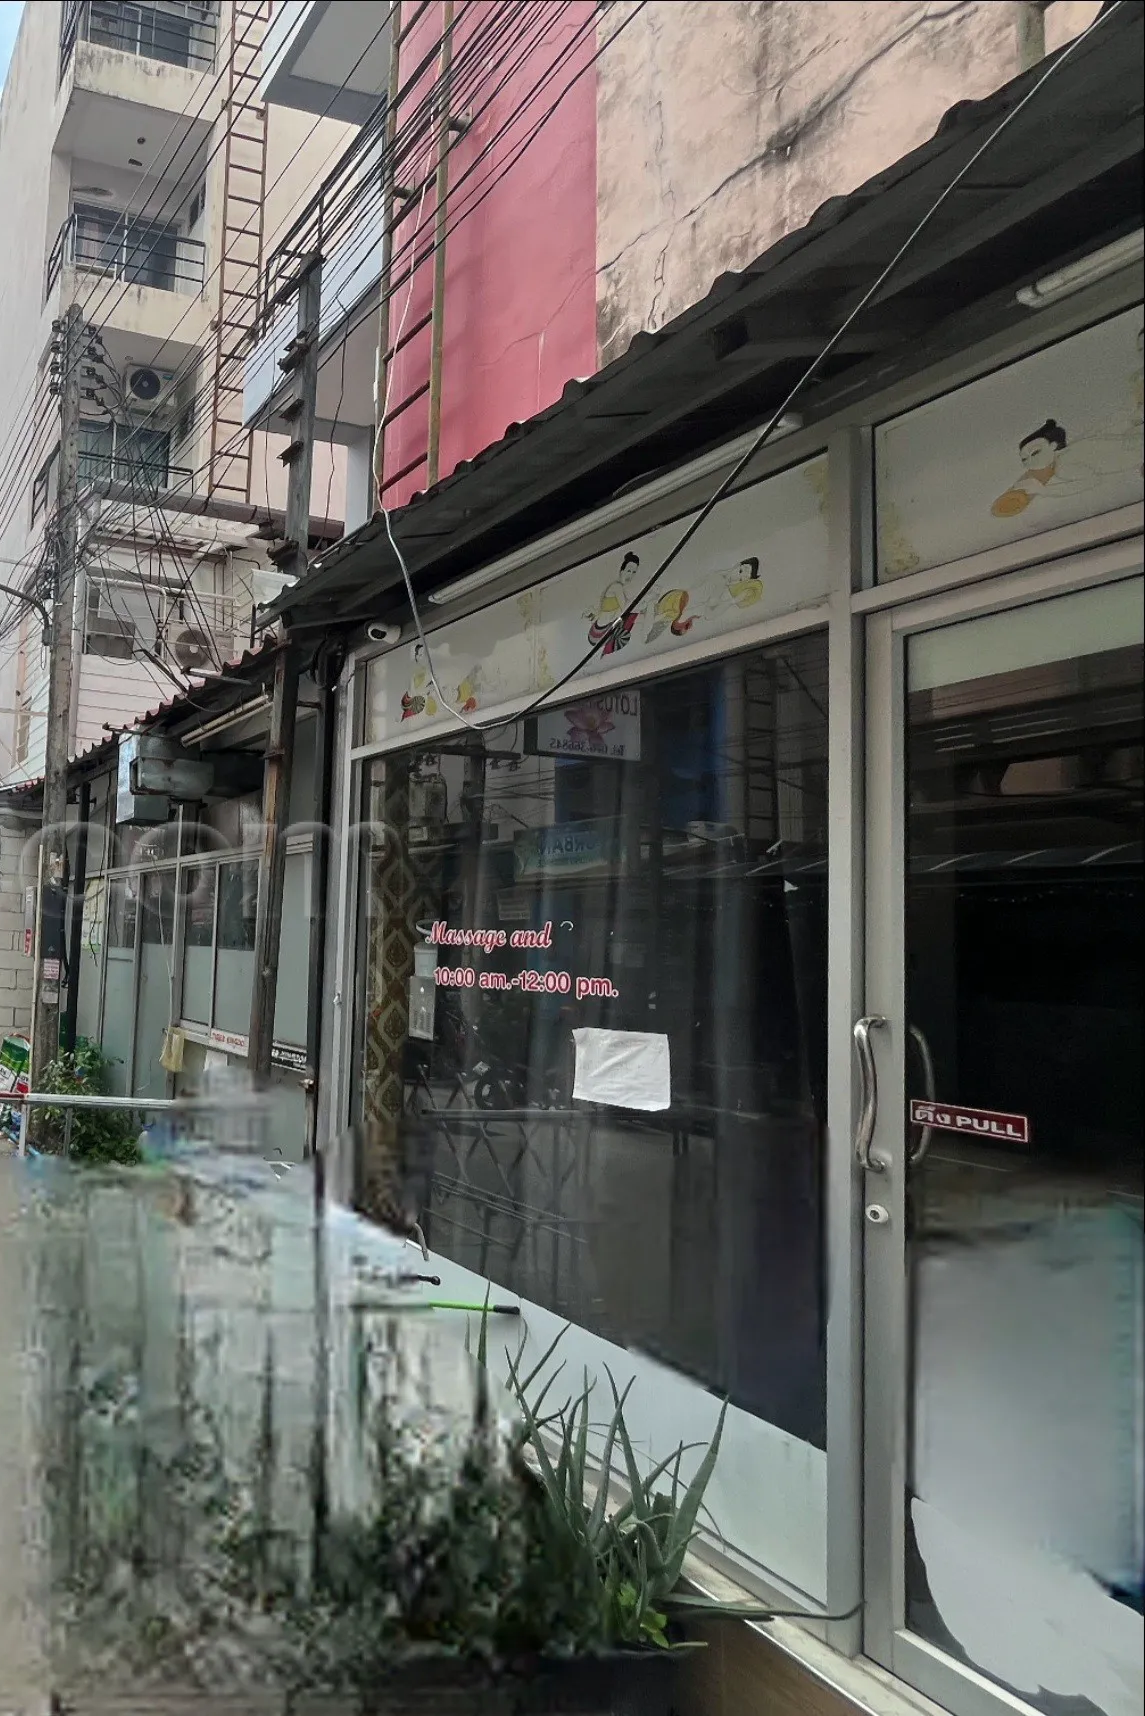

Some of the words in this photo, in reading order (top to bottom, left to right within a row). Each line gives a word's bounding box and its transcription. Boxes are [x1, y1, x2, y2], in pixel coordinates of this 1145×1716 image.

[425, 921, 507, 953] Massage
[510, 921, 553, 948] and
[433, 966, 475, 987] 10:00
[575, 975, 620, 1000] pm.
[956, 1115, 1022, 1137] PULL
